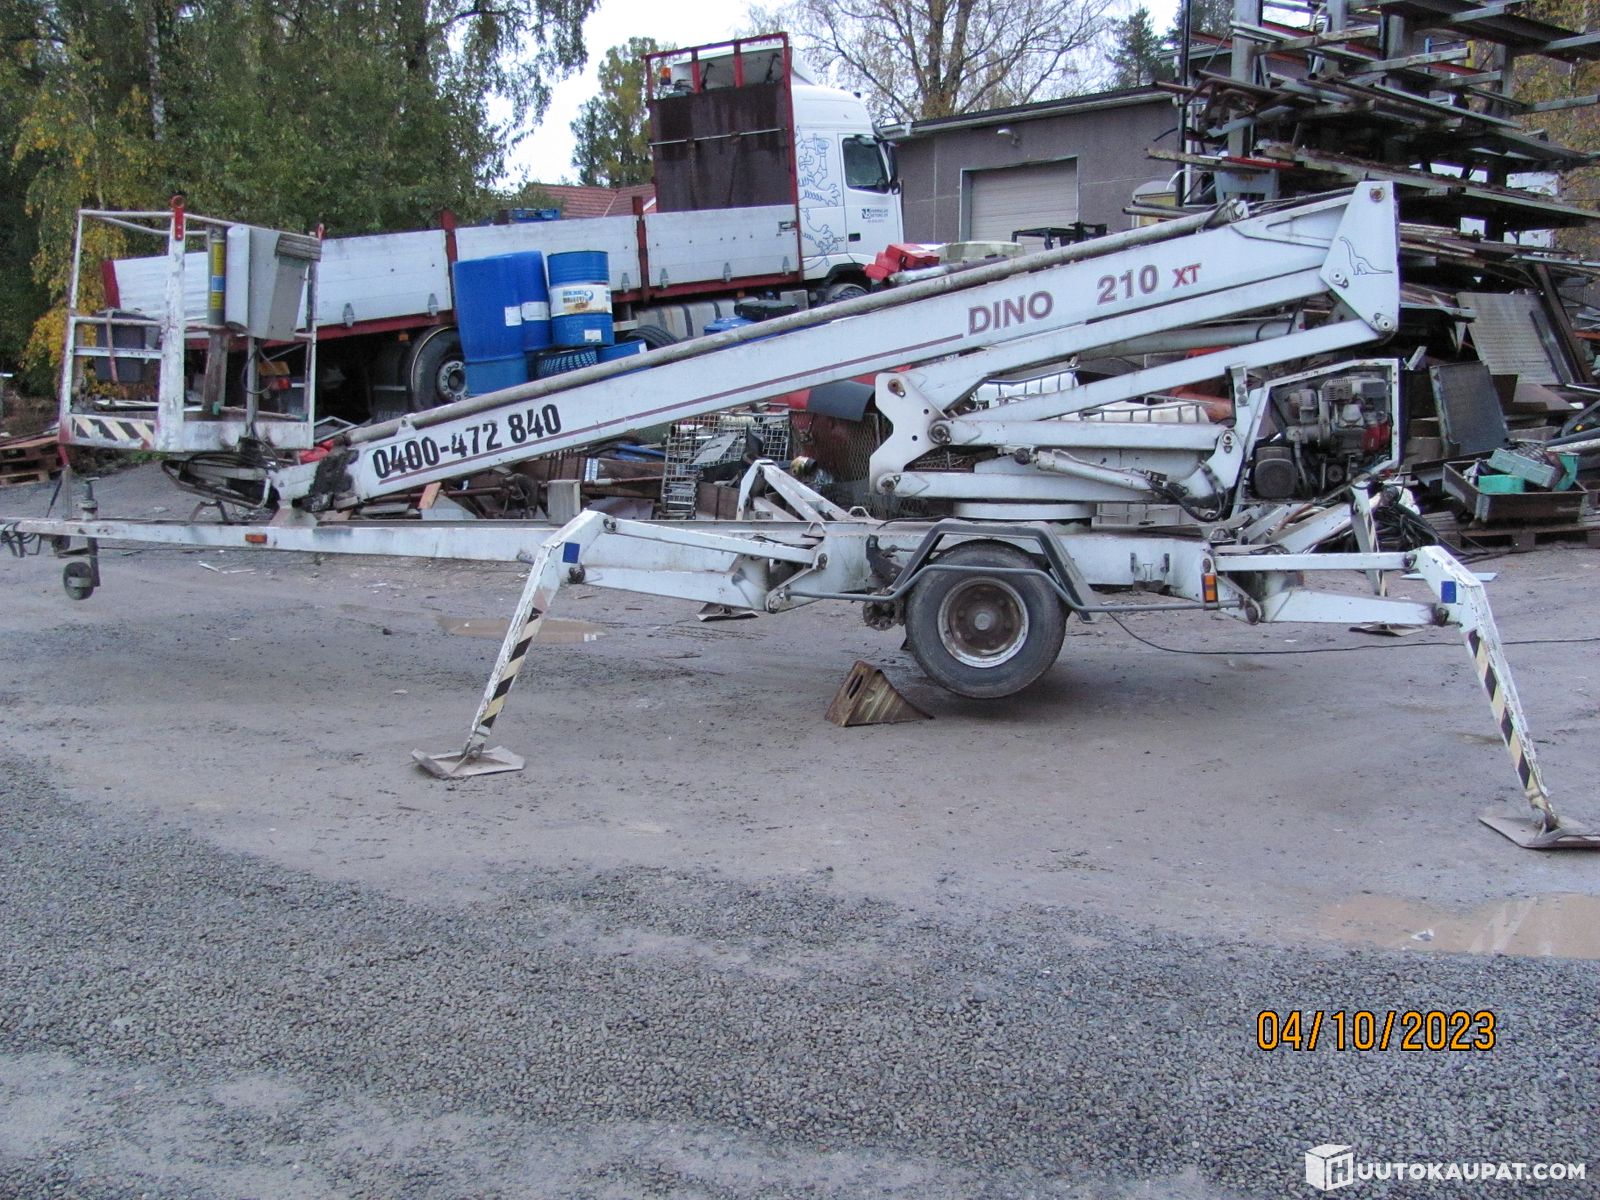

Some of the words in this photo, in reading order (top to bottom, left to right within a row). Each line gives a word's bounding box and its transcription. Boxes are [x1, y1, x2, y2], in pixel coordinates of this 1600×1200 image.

[968, 290, 1054, 335] DINO
[1096, 264, 1159, 305] 210
[1172, 263, 1202, 289] XT
[373, 421, 503, 479] 0400-472
[508, 403, 562, 444] 840
